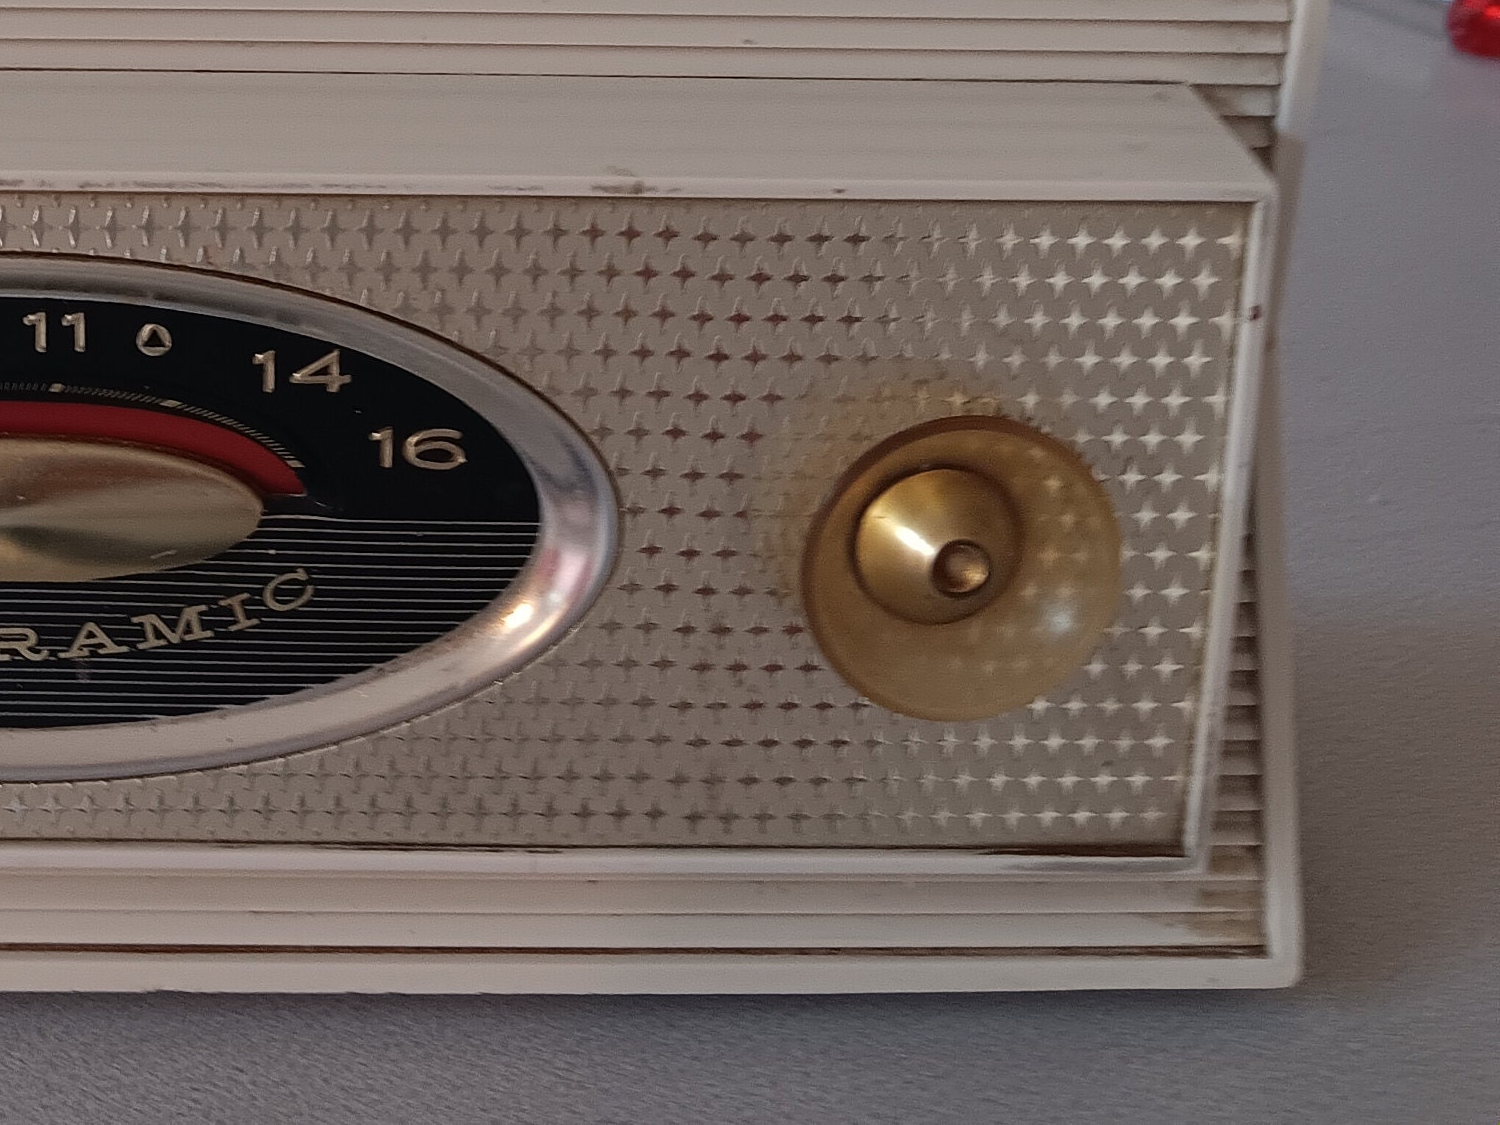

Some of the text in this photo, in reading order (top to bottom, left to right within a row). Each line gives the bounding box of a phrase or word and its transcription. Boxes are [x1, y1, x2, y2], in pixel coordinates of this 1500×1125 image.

[22, 311, 85, 352] 11
[252, 349, 351, 393] 14
[368, 426, 468, 471] 16
